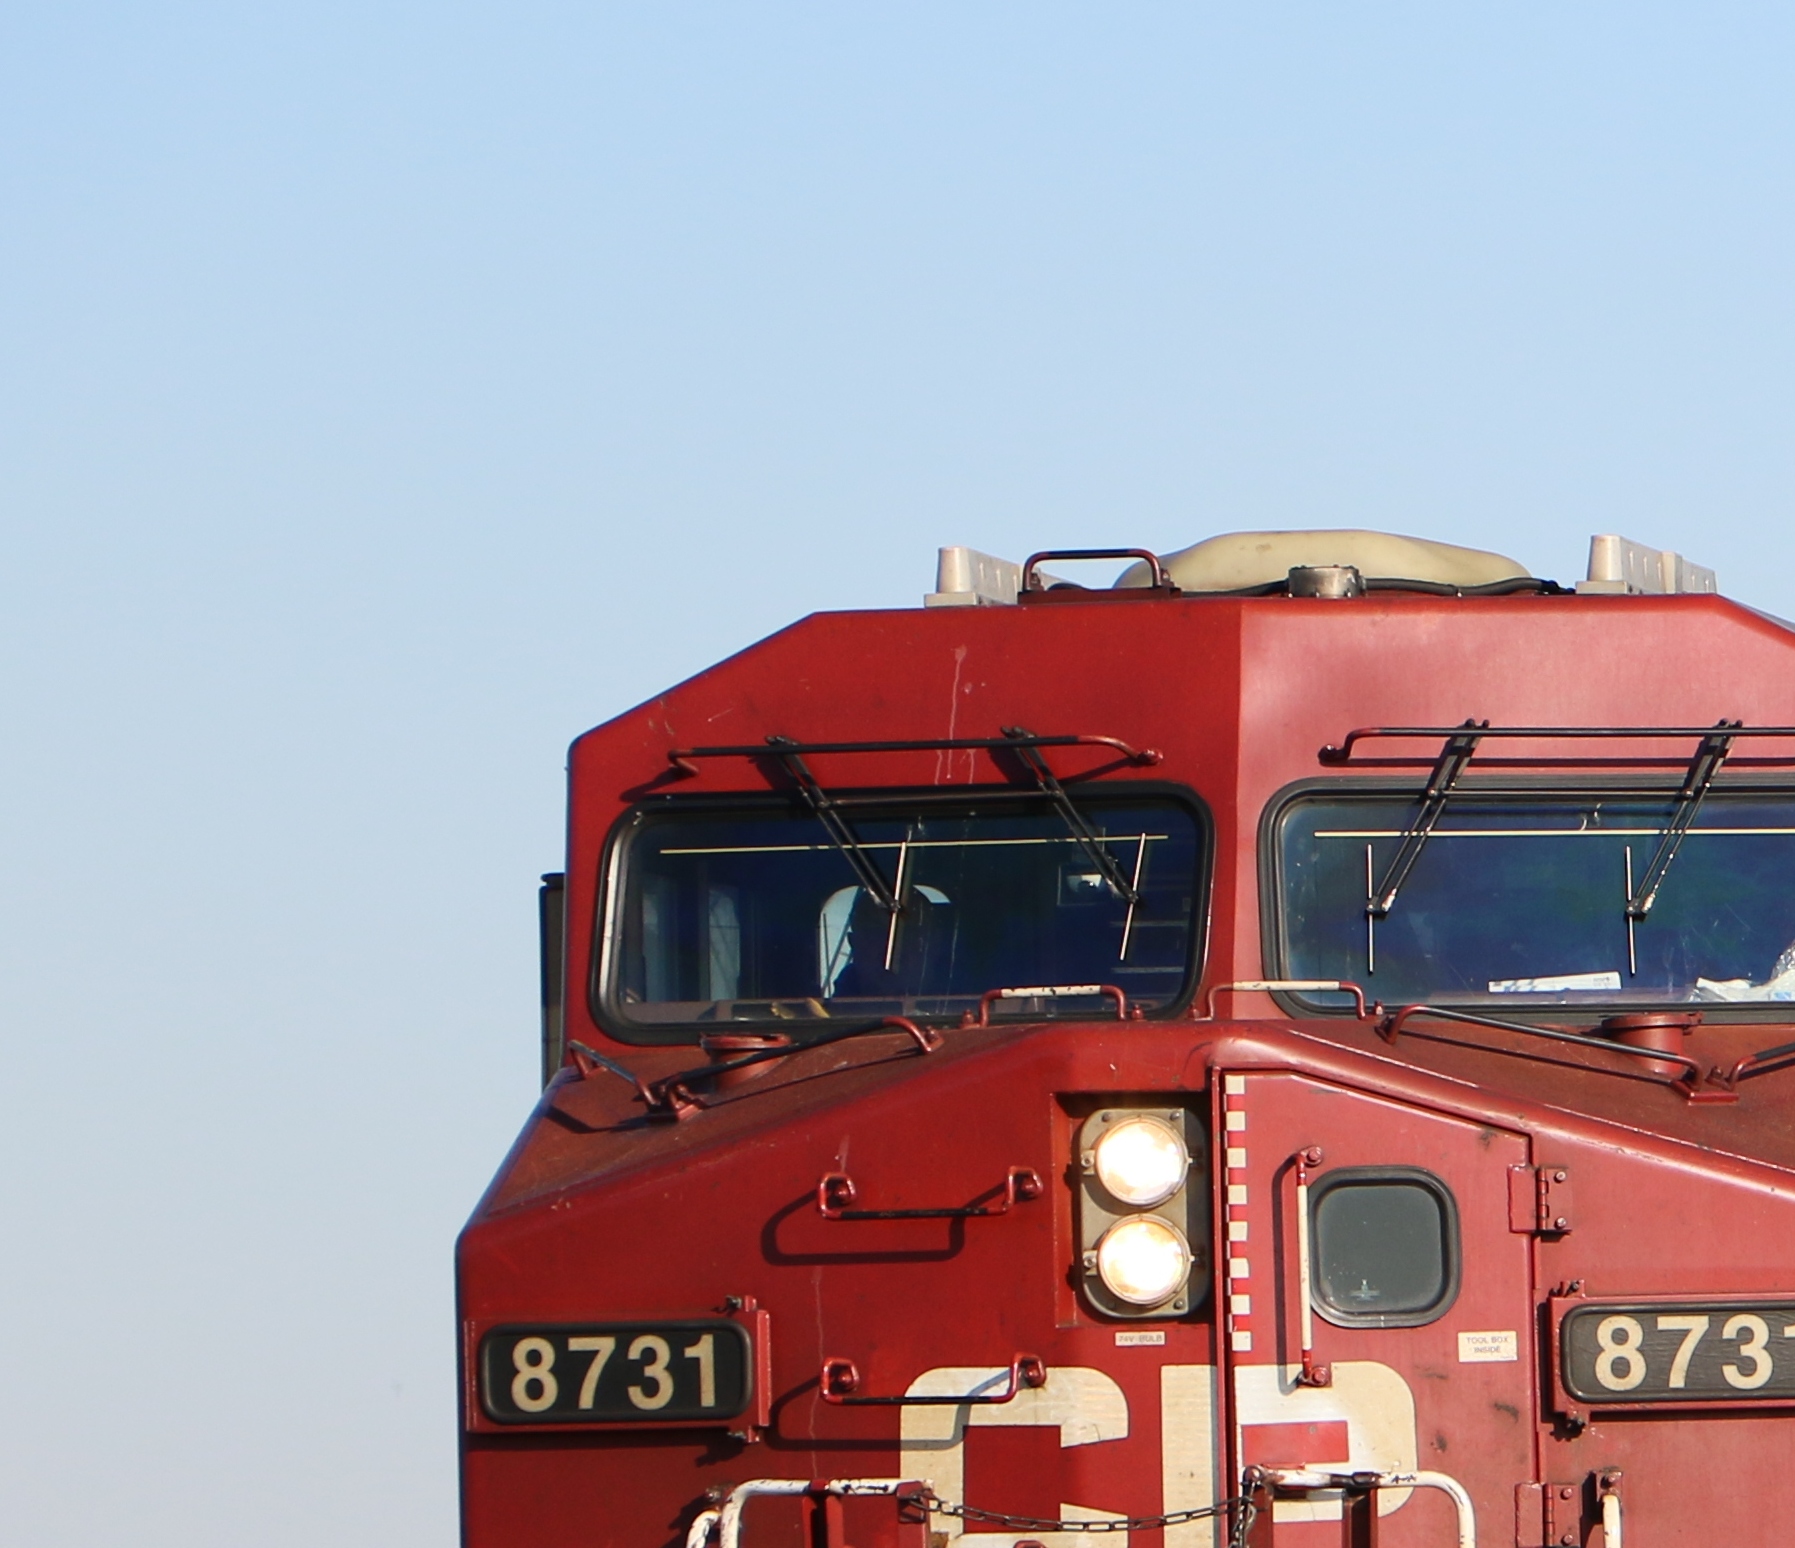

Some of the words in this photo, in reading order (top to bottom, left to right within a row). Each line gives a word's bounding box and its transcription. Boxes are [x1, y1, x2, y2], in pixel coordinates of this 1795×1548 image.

[1465, 1336, 1489, 1345] TOOL
[1491, 1335, 1509, 1344] BOX
[512, 1335, 716, 1412] 8731
